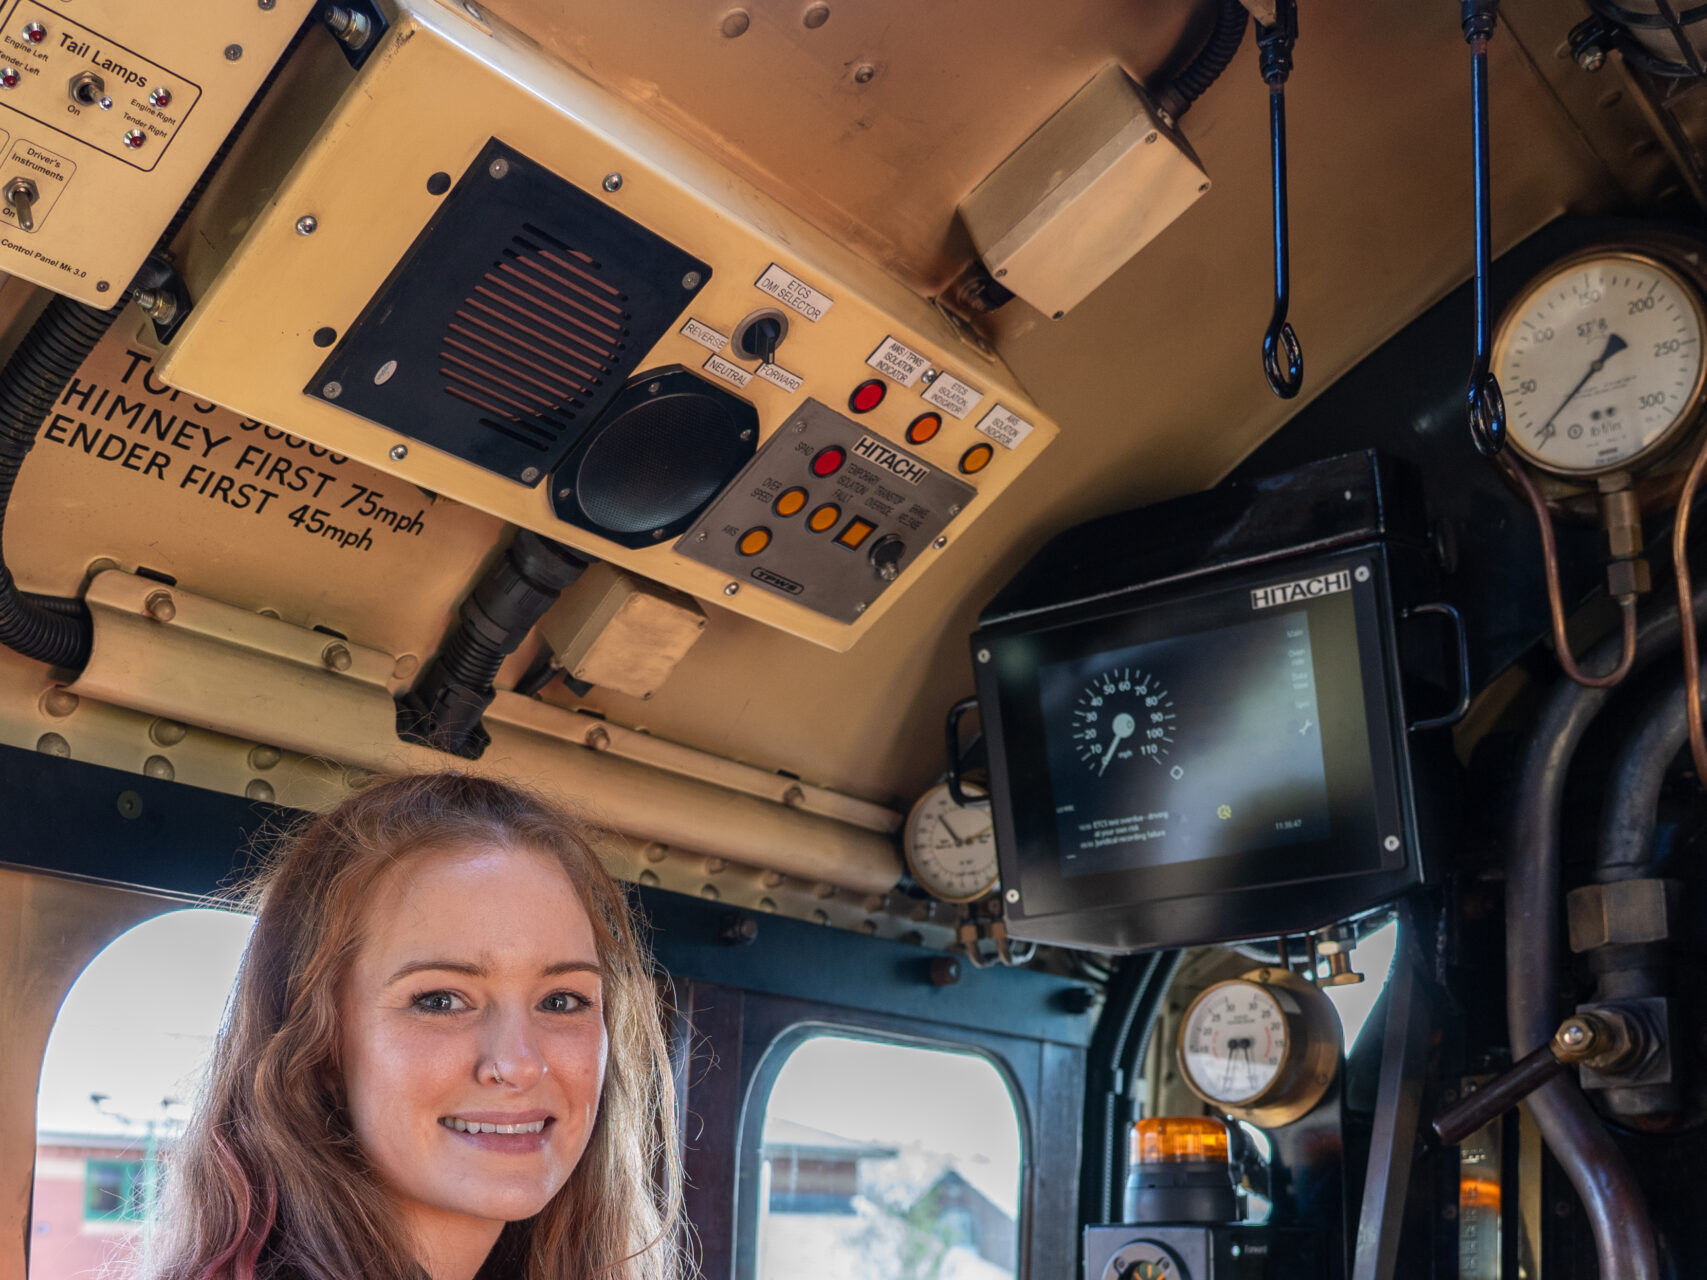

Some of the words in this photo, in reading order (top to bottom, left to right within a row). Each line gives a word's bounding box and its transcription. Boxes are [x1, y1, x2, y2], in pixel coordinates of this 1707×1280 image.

[4, 35, 32, 54] Engine
[33, 49, 49, 62] Left
[0, 50, 23, 67] ender
[24, 63, 40, 76] Left
[59, 32, 91, 58] Tail
[90, 50, 148, 88] Lamps
[67, 104, 81, 116] On
[130, 98, 156, 116] Engine
[156, 111, 176, 126] Right
[122, 111, 147, 128] Tender
[147, 124, 168, 139] Right
[11, 152, 64, 182] Instruments
[26, 147, 61, 169] Driver's
[2, 207, 16, 218] On
[1, 238, 34, 257] Control
[34, 252, 59, 267] Panel
[59, 262, 72, 273] Mk
[73, 267, 87, 279] 3.0
[761, 277, 780, 294] DMI
[777, 288, 822, 320] SELECTOR
[786, 279, 812, 299] ETCS
[1578, 289, 1601, 307] 150
[1627, 295, 1656, 316] 200
[685, 323, 726, 350] REVERSE
[1532, 327, 1555, 345] 100
[1653, 338, 1681, 358] 250
[875, 360, 908, 383] INDICATOR
[883, 351, 915, 374] ISOLATION
[708, 359, 748, 387] NEUTRAL
[761, 364, 800, 391] FORWARD
[938, 386, 969, 407] ISOLATION
[951, 382, 969, 395] ETCS
[1519, 379, 1537, 396] 50
[931, 394, 962, 415] INDICATOR
[1638, 391, 1667, 411] 300
[984, 426, 1013, 446] INDICATOR
[991, 417, 1020, 438] ISOLATION
[61, 377, 232, 458] HIMNEY
[234, 444, 337, 498] FIRST
[340, 483, 425, 536] 75mph
[853, 437, 928, 484] HITACHI
[43, 412, 171, 480] ENDER
[180, 464, 279, 514] FIRST
[287, 503, 373, 551] 45mph
[762, 477, 783, 492] OVER
[750, 487, 774, 504] SPEED
[757, 571, 798, 592] TPWS
[1252, 572, 1349, 608] HITACHI
[1103, 684, 1116, 695] 50
[1118, 681, 1131, 691] 60
[1134, 685, 1147, 696] 70
[1091, 696, 1103, 706] 40
[1145, 696, 1158, 707] 80
[1086, 711, 1098, 723] 30
[1150, 712, 1163, 723] 90
[1084, 728, 1097, 739] 20
[1146, 727, 1164, 739] 100
[1090, 743, 1102, 754] 10
[1141, 743, 1158, 756] 110
